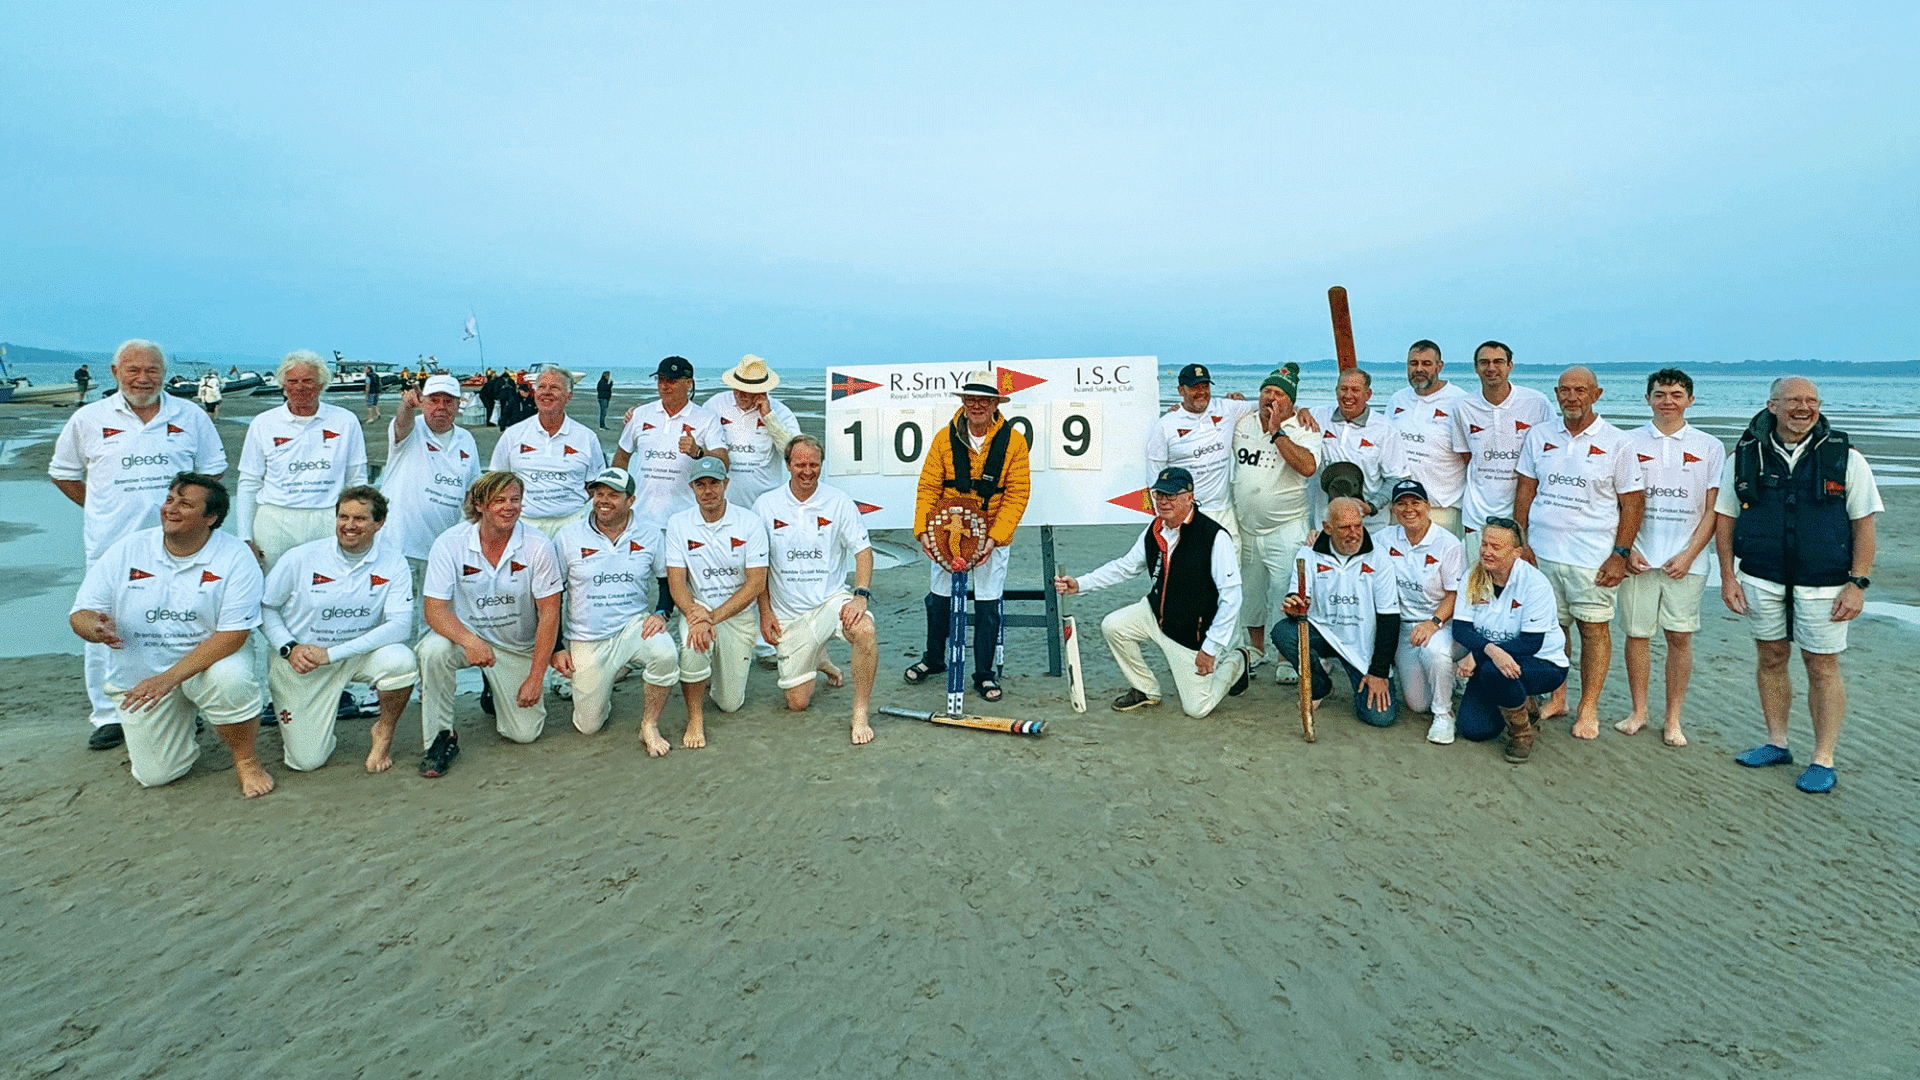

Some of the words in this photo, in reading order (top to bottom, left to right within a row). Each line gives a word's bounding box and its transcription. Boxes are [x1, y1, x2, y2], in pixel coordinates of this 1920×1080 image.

[891, 372, 945, 391] R.Srn
[1077, 365, 1130, 385] I.S.C
[890, 392, 909, 401] Royal
[912, 391, 941, 400] Southern
[1074, 385, 1093, 393] Island
[1095, 385, 1117, 393] Sailing
[1118, 384, 1134, 392] Club
[844, 420, 863, 461] 1
[894, 421, 923, 462] 0
[1061, 414, 1091, 456] 9
[644, 449, 677, 461] gleeds
[727, 443, 755, 453] leeds
[1193, 442, 1224, 458] gleeds
[1484, 448, 1519, 461] gleeds
[122, 453, 169, 470] gleeds
[1238, 448, 1261, 466] 9d
[288, 458, 331, 474] gleeds
[1548, 472, 1587, 488] gleeds
[1644, 485, 1688, 498] gleeds
[786, 548, 823, 562] gleeds
[592, 570, 634, 587] gleeds
[702, 566, 739, 580] gleeds
[476, 594, 516, 610] gleeds
[145, 607, 197, 624] gleeds
[321, 605, 371, 621] gleeds
